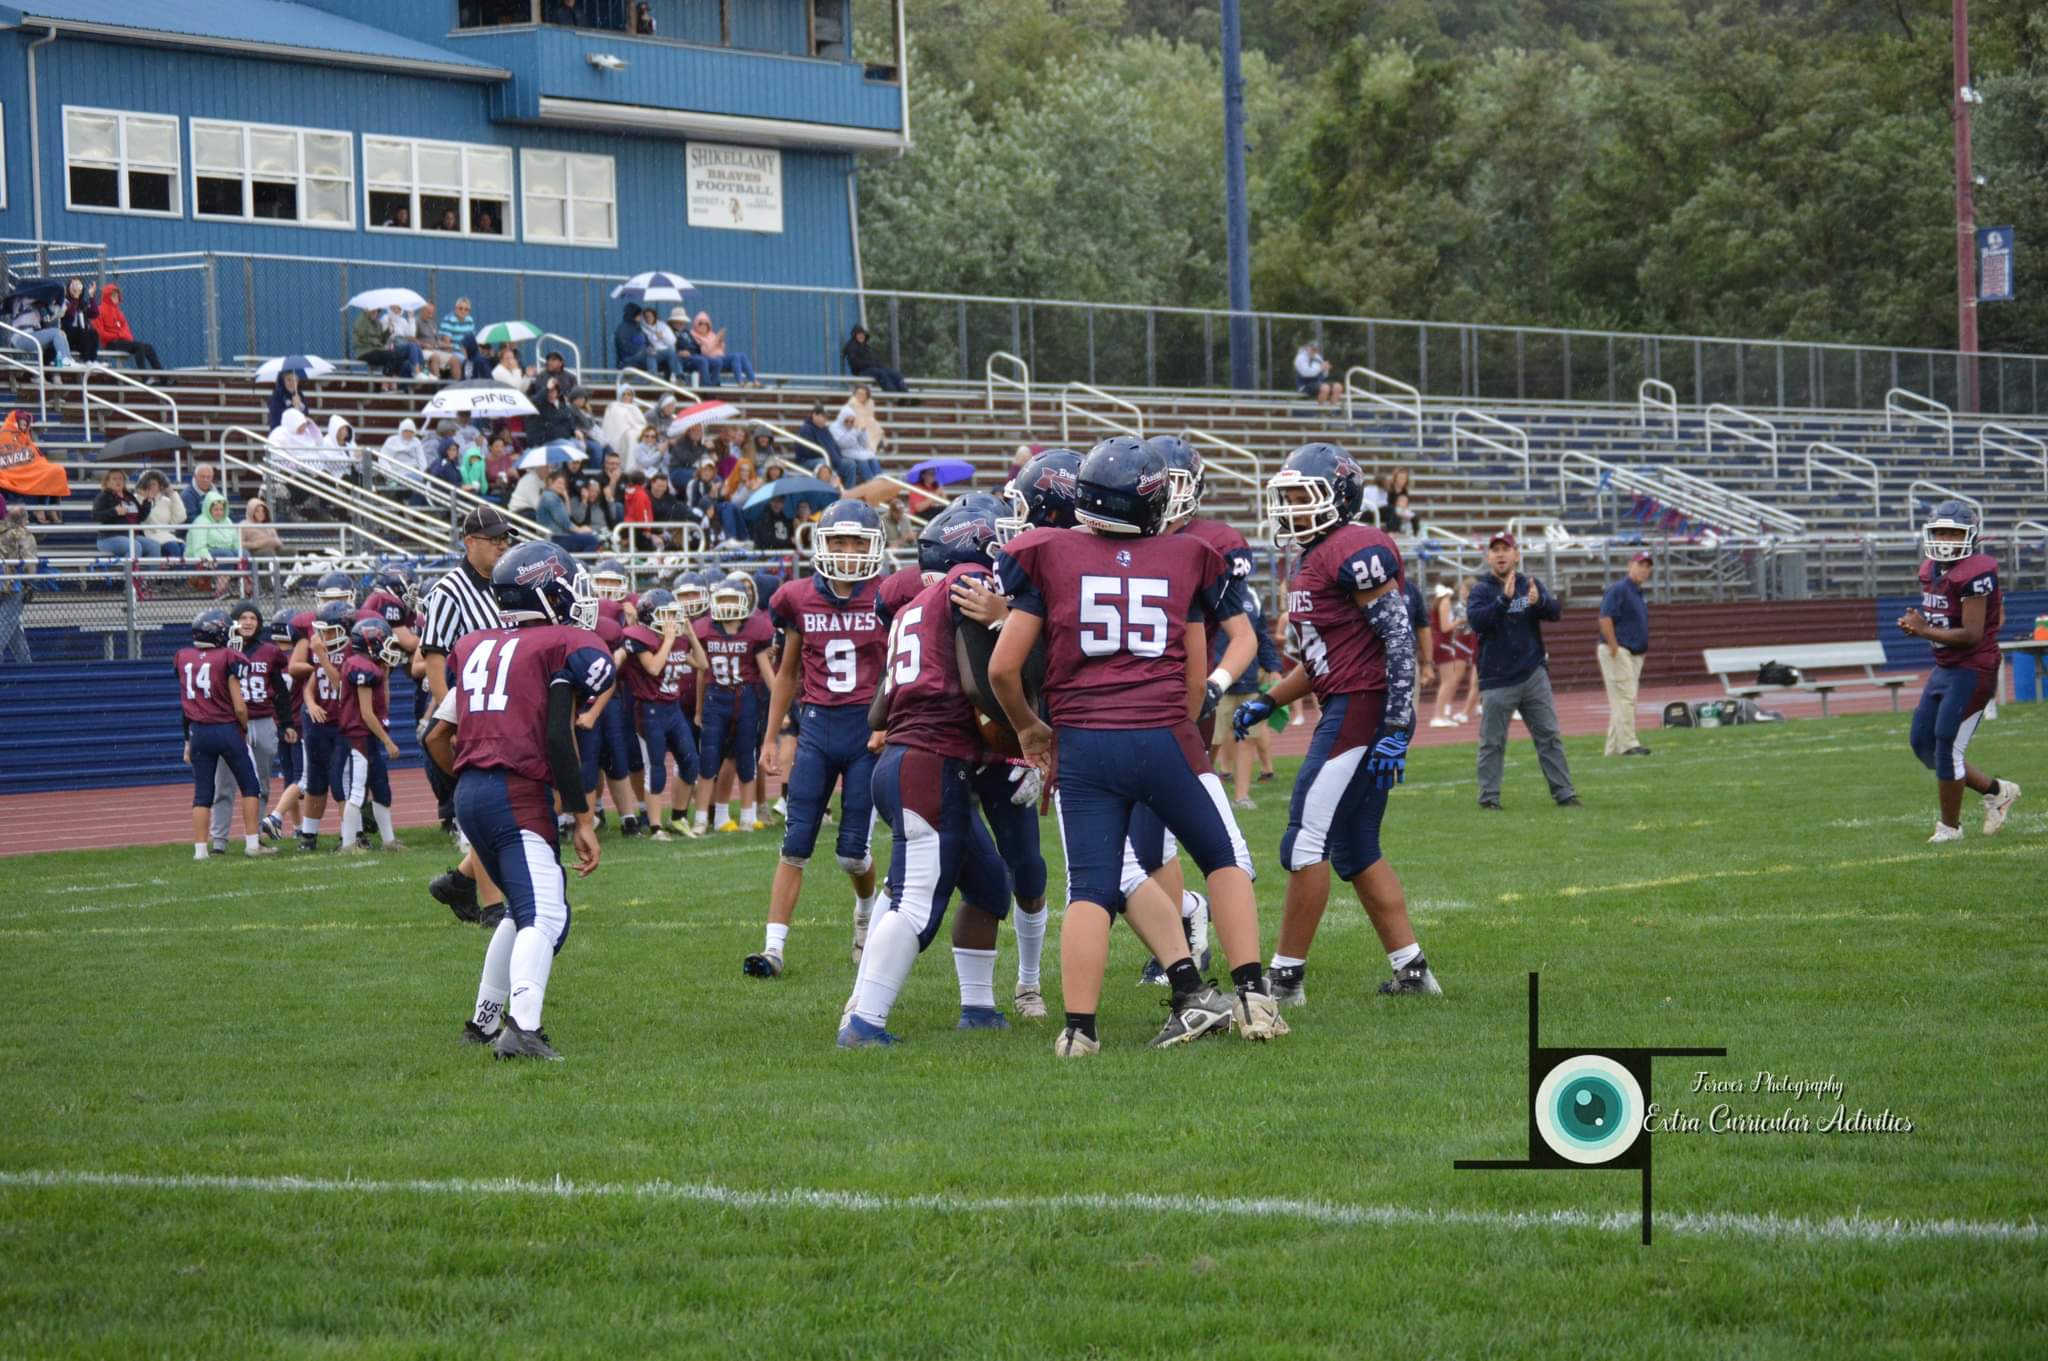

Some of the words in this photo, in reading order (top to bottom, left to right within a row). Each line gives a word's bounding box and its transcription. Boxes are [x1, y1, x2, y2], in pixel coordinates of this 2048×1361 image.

[691, 147, 776, 175] SHIKELLAMY
[707, 168, 762, 182] BRAVES
[696, 180, 774, 196] FOOTBALL
[471, 393, 517, 407] PING
[1351, 554, 1389, 591] 24
[803, 613, 876, 632] BRAVES
[1079, 575, 1169, 658] 55
[708, 641, 748, 654] BRAVES
[462, 638, 520, 712] 41
[585, 657, 613, 692] 41
[825, 639, 857, 693] 9
[184, 662, 211, 699] 14
[477, 1011, 494, 1024] DO
